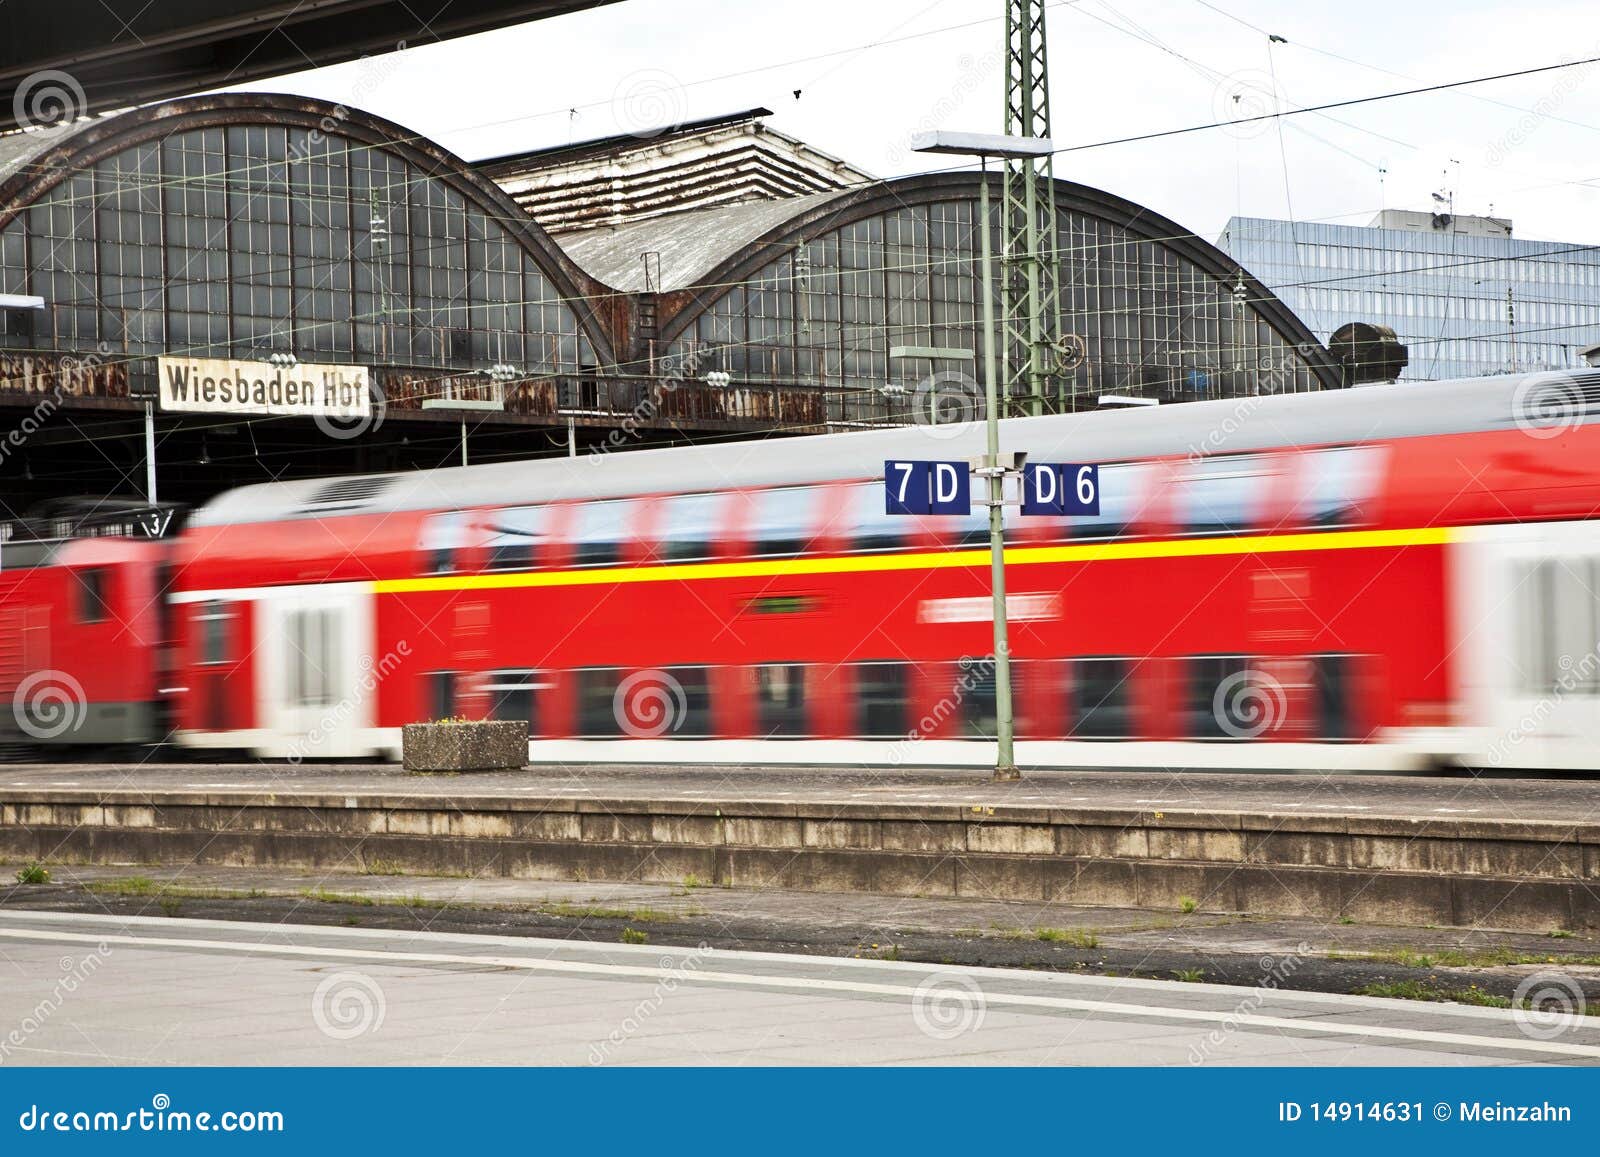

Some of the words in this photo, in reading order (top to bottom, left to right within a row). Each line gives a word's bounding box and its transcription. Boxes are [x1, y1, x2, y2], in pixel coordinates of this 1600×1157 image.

[167, 364, 315, 406] Wiesbaden
[322, 371, 363, 408] Hbf
[894, 463, 914, 503] 7
[936, 463, 959, 503] D
[1035, 465, 1056, 504] D
[1076, 465, 1095, 505] 6
